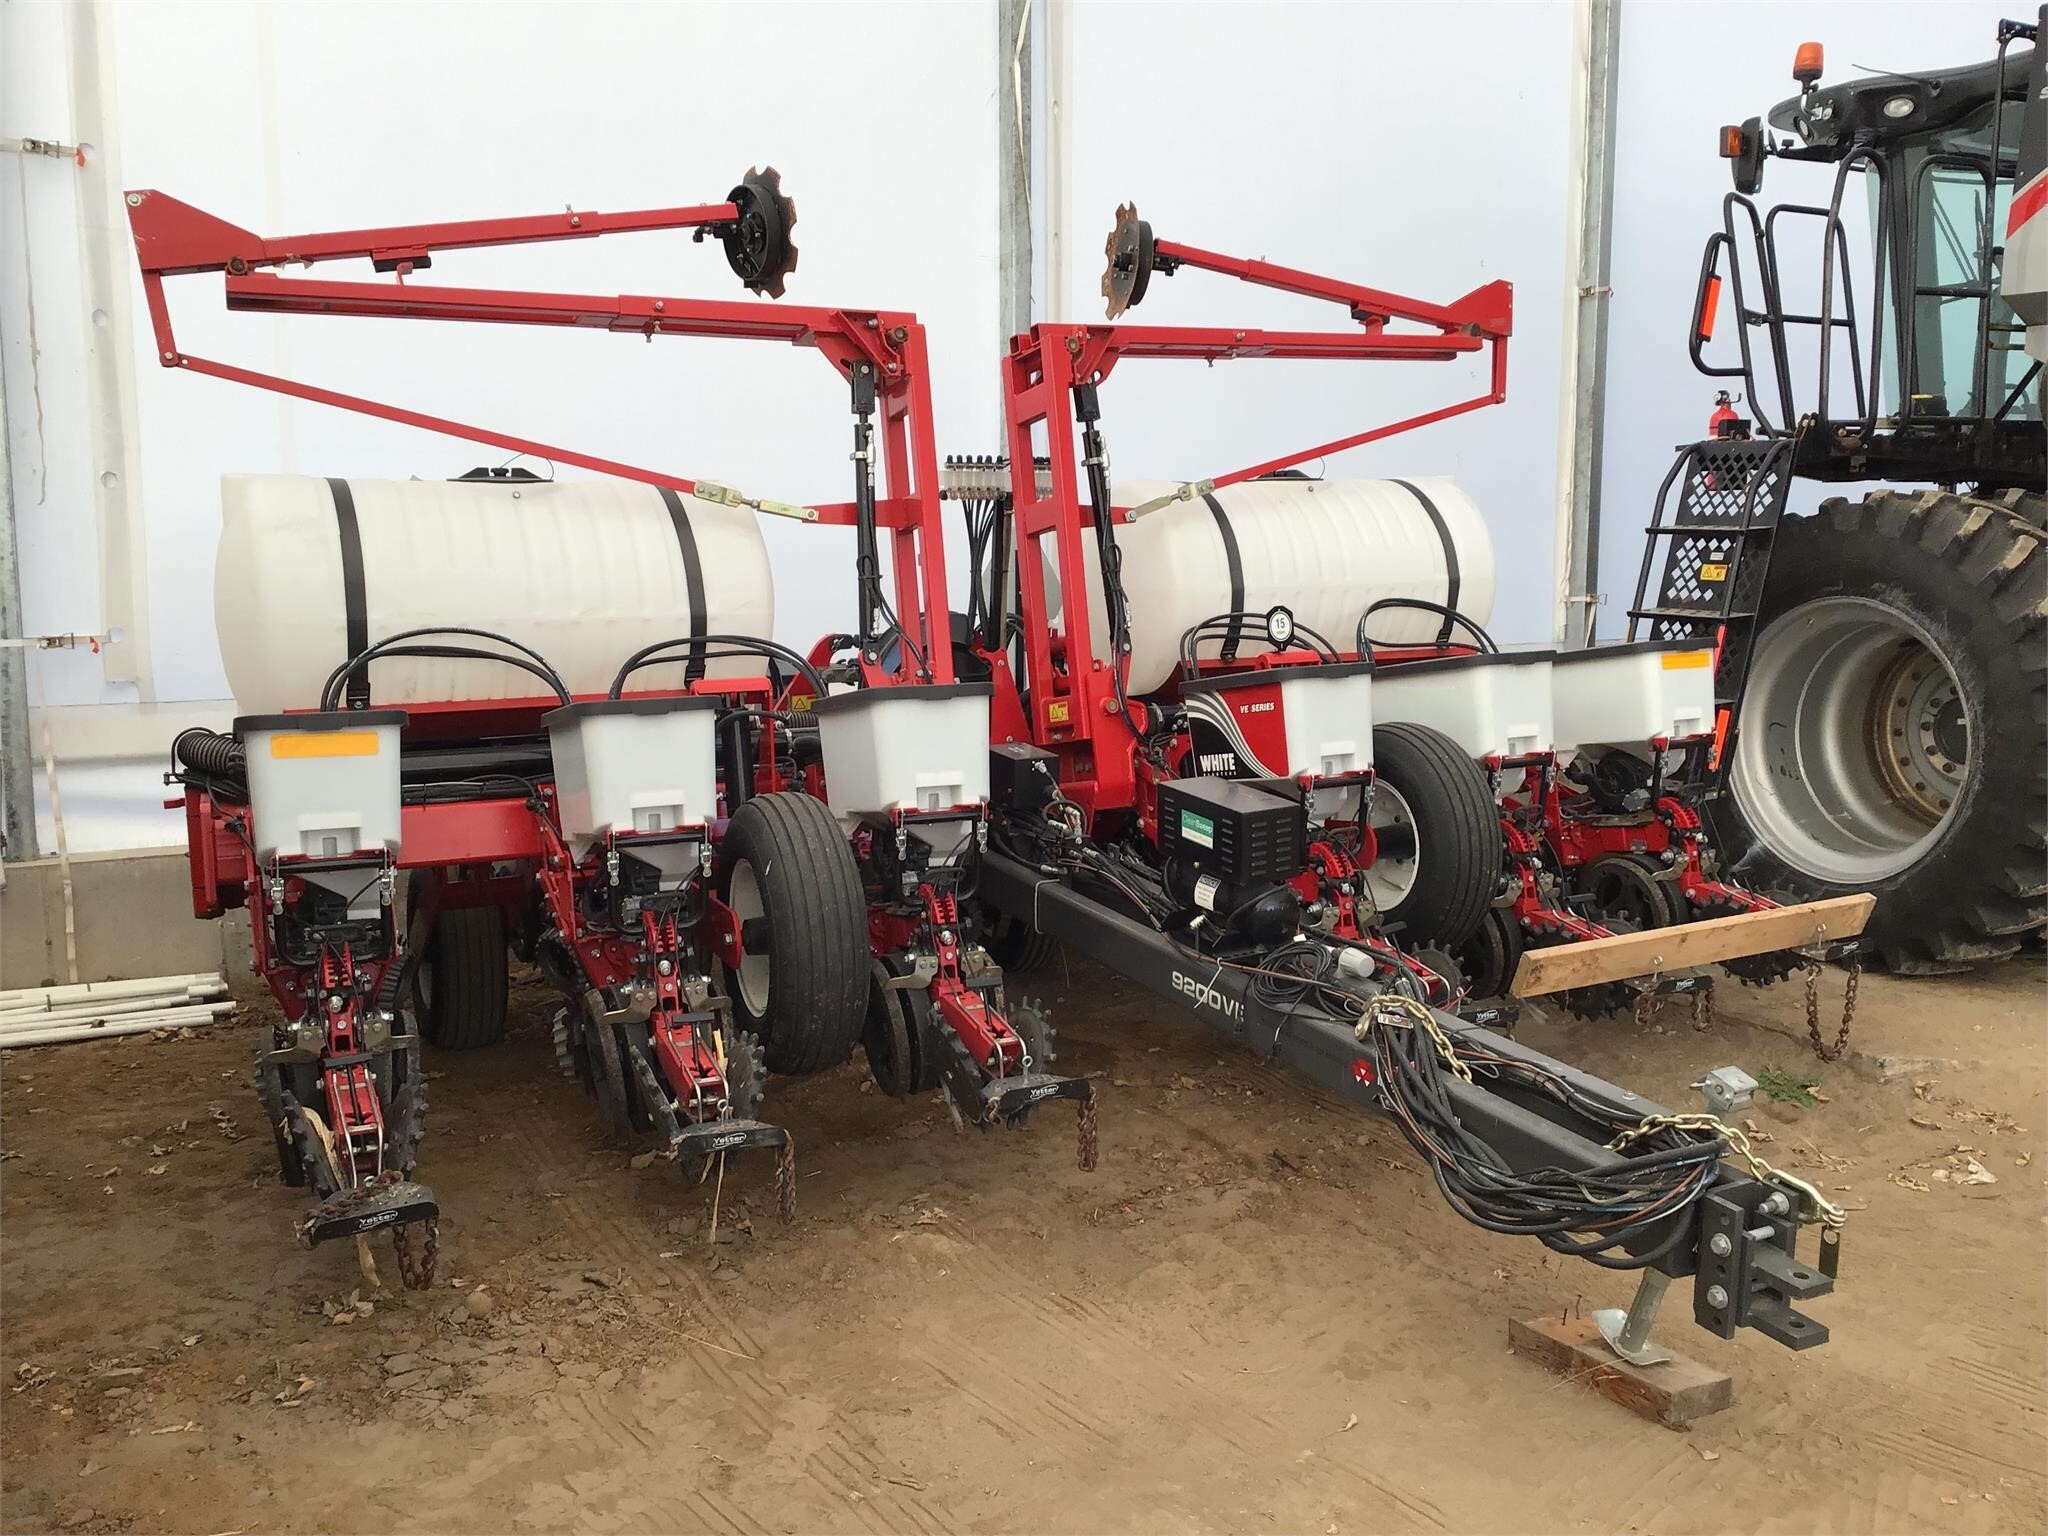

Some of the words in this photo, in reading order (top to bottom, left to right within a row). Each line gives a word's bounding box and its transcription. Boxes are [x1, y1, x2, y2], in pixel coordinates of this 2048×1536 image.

[1251, 702, 1275, 713] SERIES
[1200, 753, 1236, 772] WHITE
[1030, 1085, 1059, 1098] Yetter
[713, 1134, 745, 1147] Yetter
[360, 1212, 397, 1227] Yetter
